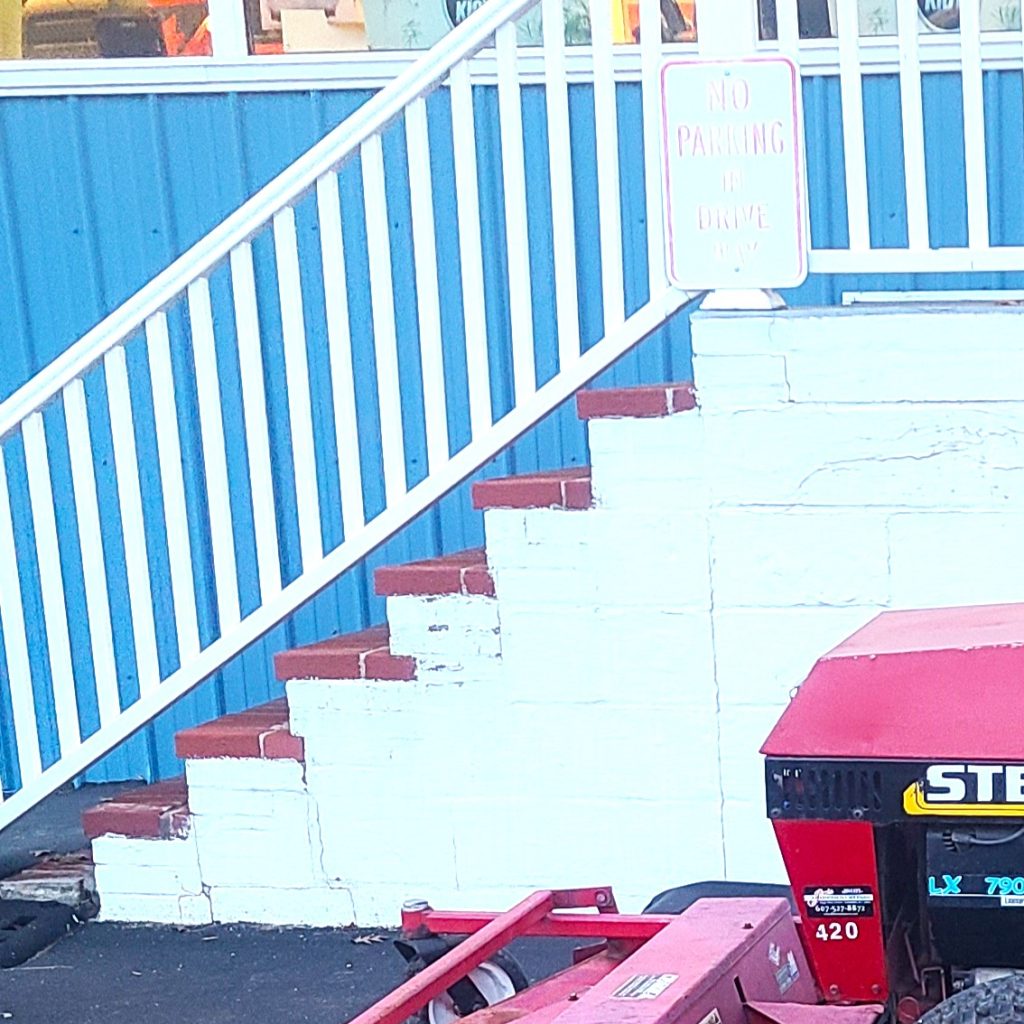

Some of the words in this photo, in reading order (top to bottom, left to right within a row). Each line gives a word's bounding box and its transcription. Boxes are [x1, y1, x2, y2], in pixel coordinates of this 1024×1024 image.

[708, 78, 750, 112] NO
[677, 121, 785, 157] PARKING
[697, 203, 772, 231] DRIVE
[928, 875, 963, 895] LX
[815, 921, 859, 941] 420
